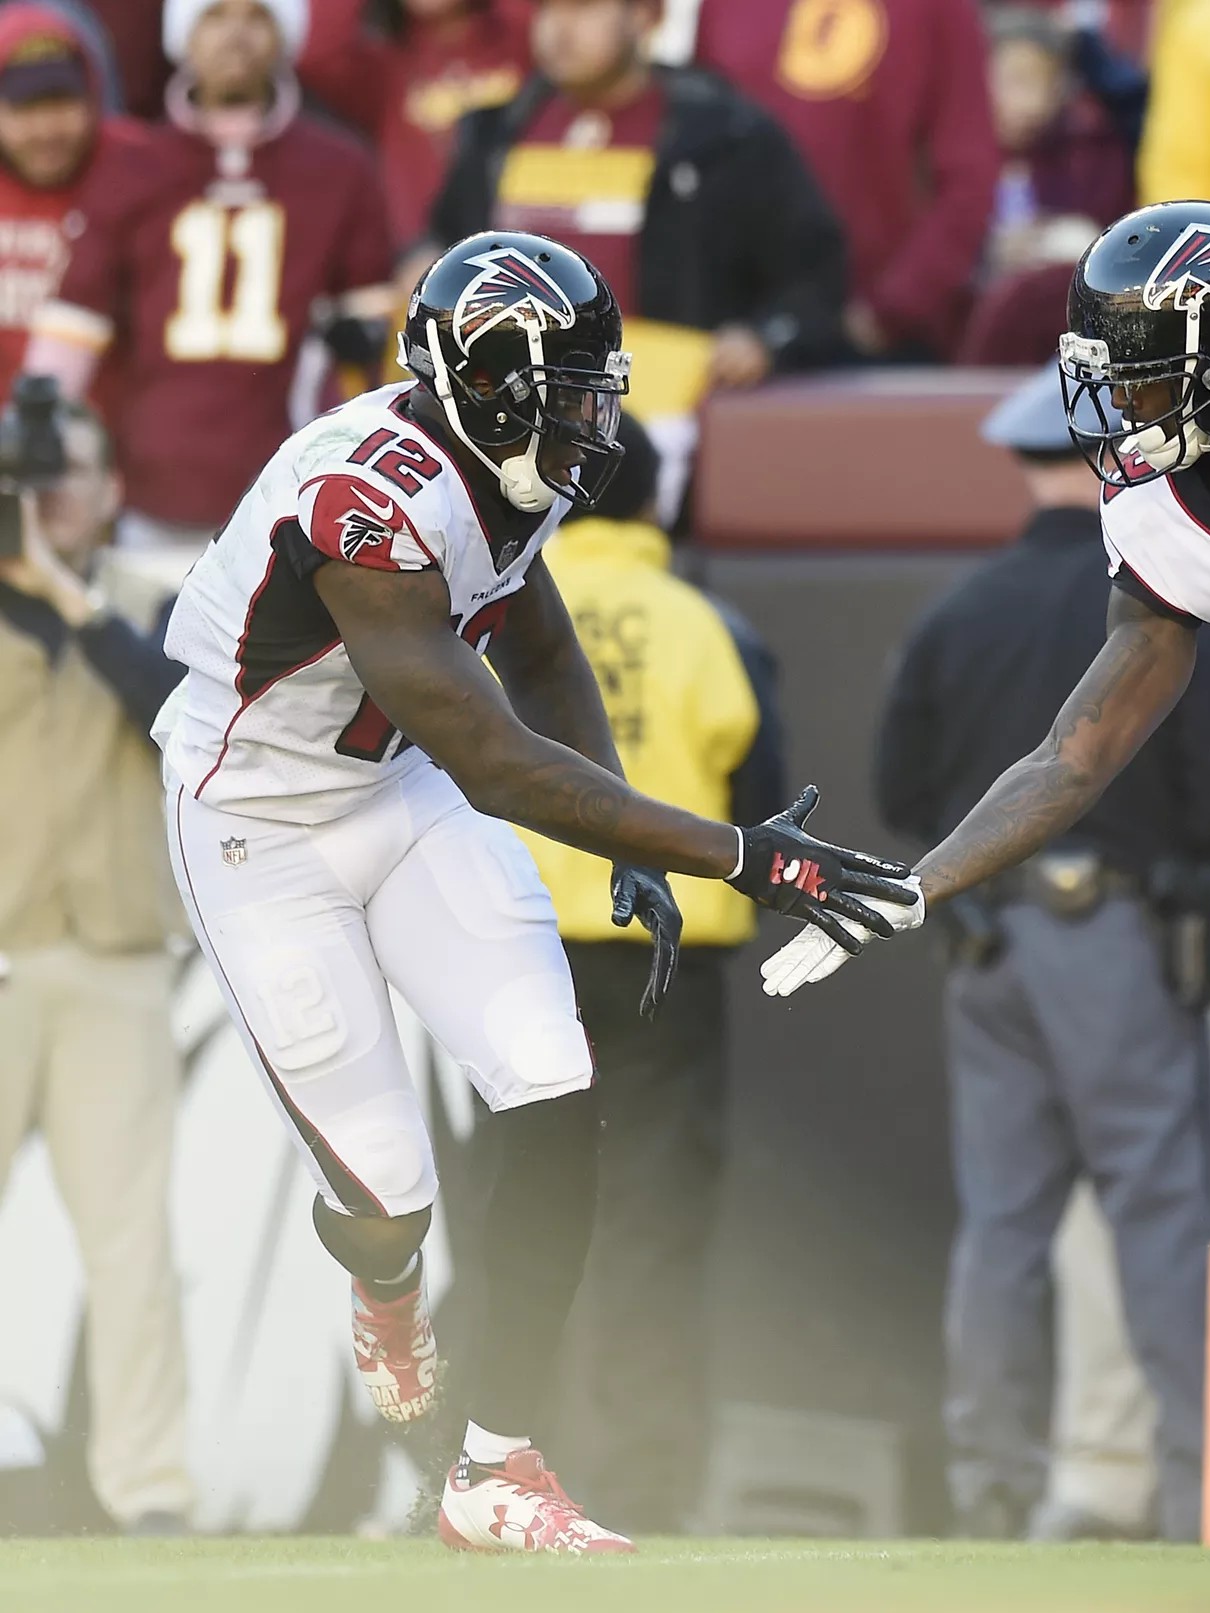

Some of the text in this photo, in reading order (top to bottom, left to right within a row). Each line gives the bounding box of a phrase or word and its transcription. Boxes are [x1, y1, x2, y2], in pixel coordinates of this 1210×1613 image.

[165, 199, 288, 362] 11
[345, 427, 443, 499] 12
[470, 577, 512, 602] FALCONS
